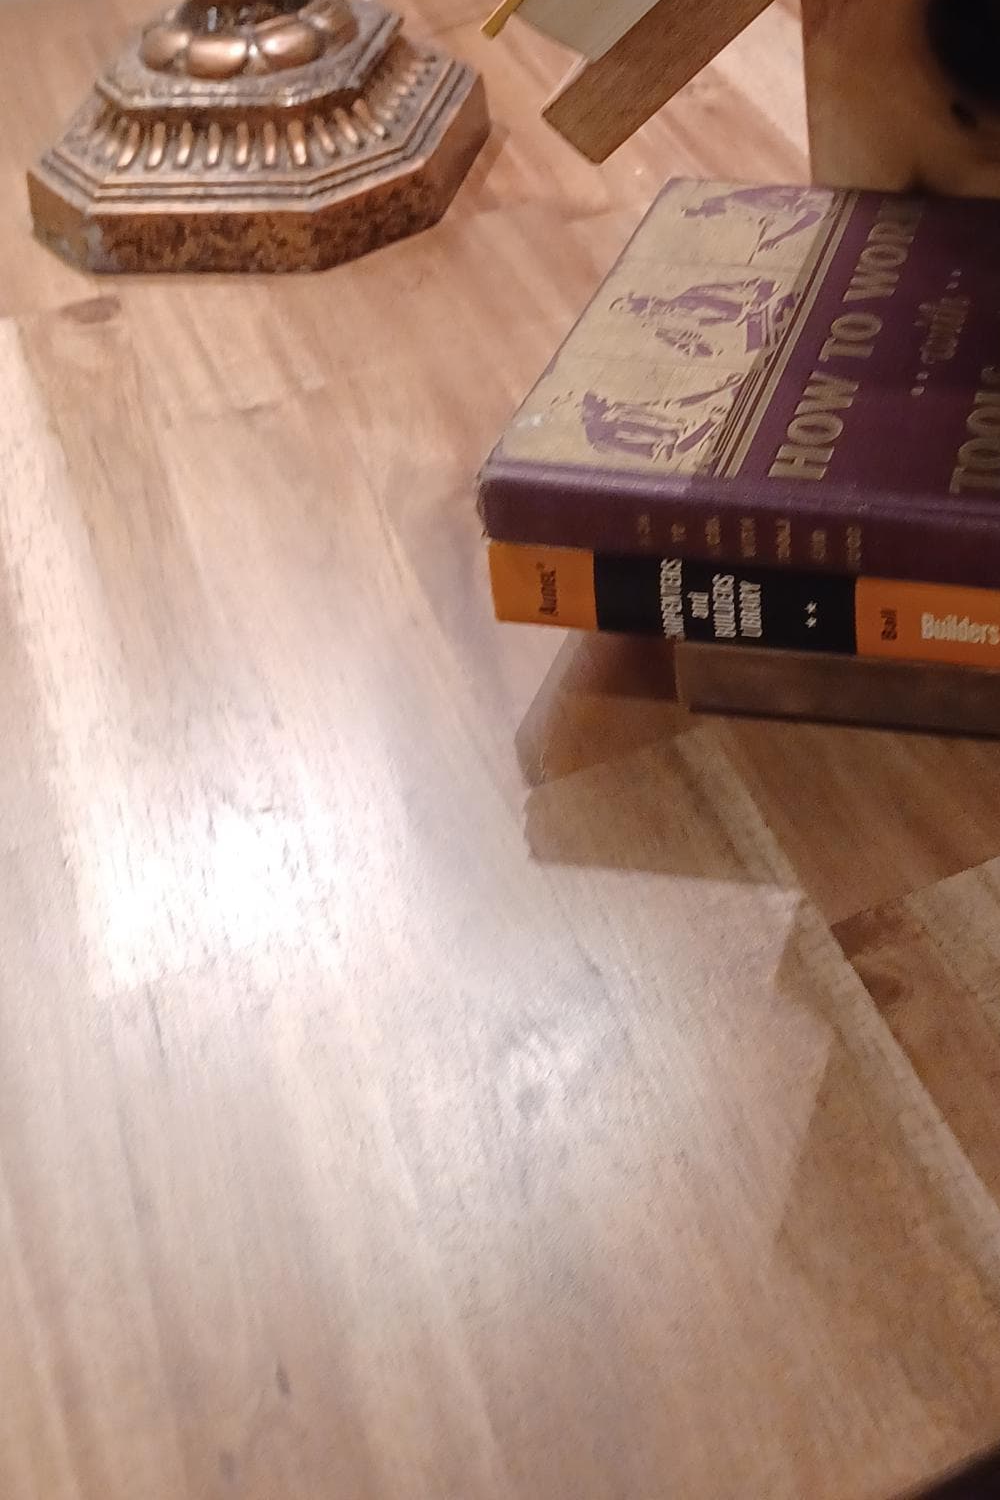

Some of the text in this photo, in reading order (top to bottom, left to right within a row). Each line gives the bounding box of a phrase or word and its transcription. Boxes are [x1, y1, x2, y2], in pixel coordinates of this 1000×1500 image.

[768, 371, 860, 481] HOW
[818, 312, 882, 363] TO
[712, 573, 737, 638] BUILDERS
[738, 580, 763, 638] LIBRARY
[921, 612, 1000, 645] Builders
